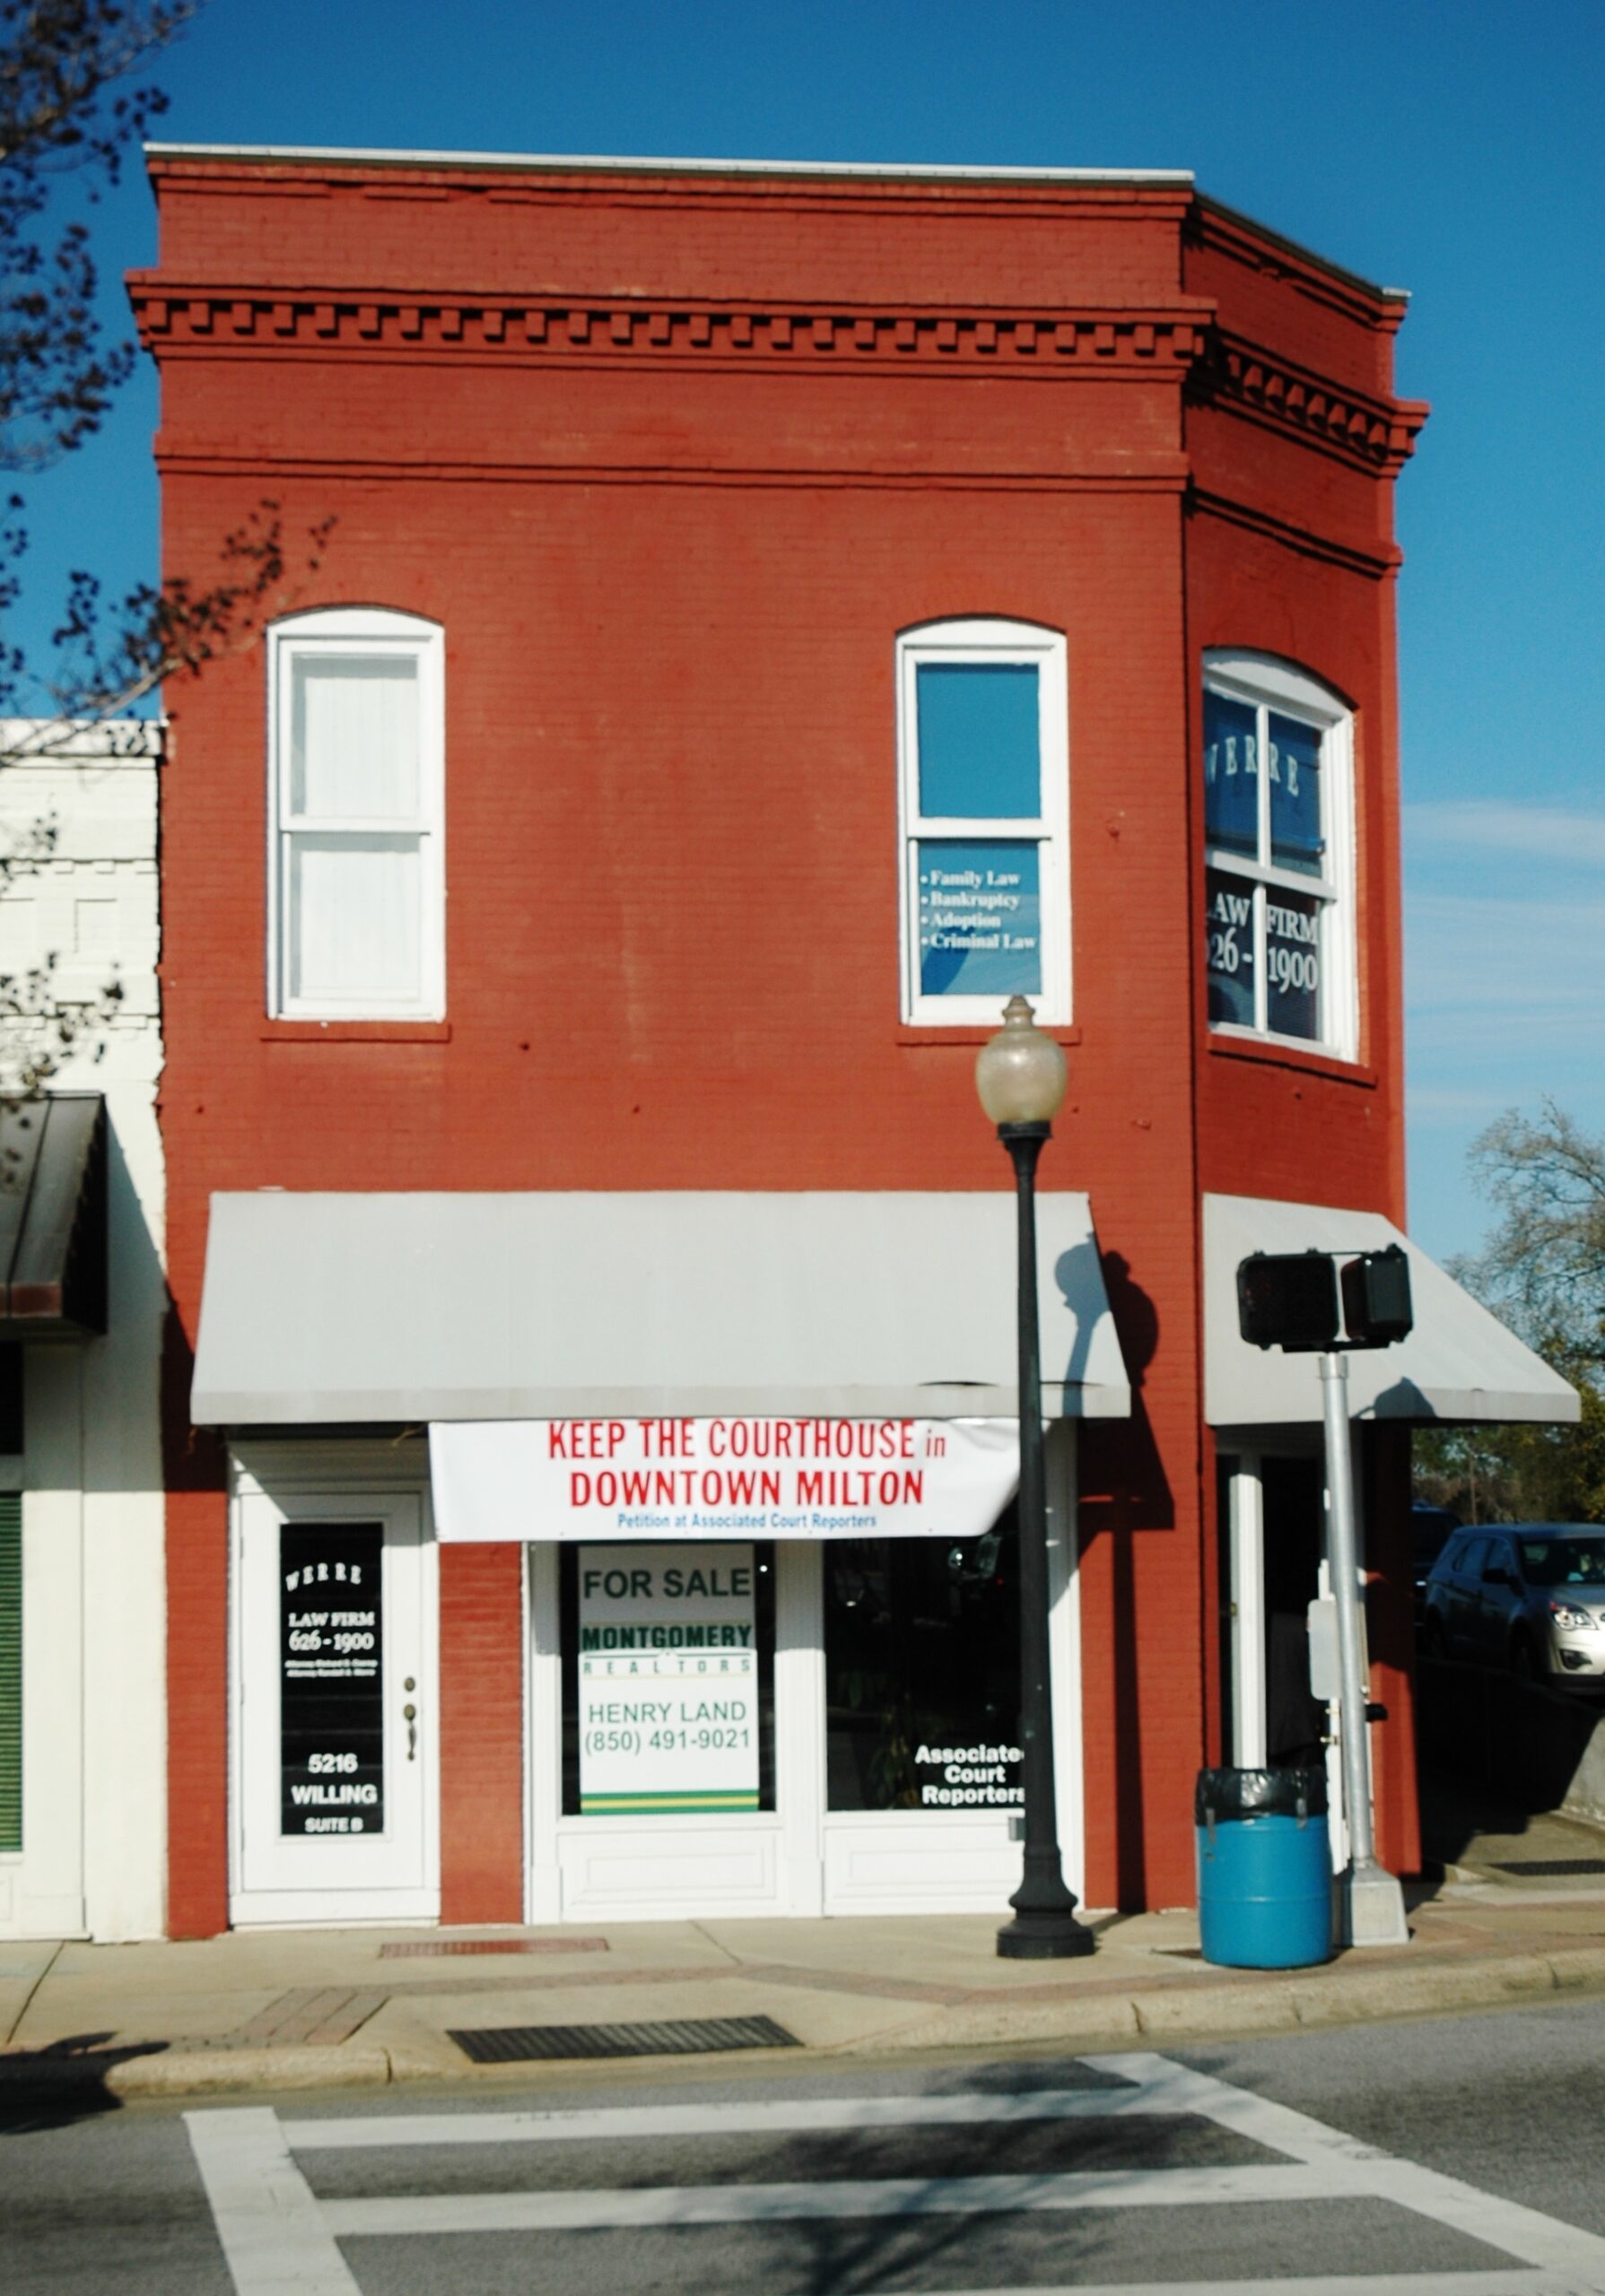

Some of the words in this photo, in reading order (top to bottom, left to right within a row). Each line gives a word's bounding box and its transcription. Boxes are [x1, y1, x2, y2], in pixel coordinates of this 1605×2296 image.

[930, 870, 982, 889] Family
[987, 871, 1021, 886] Law
[930, 891, 1021, 911] Bankruptcy
[931, 912, 1002, 931] Adoption
[1207, 891, 1252, 928] AW
[1266, 903, 1319, 946] FIRM
[930, 933, 999, 950] Criminal
[1003, 934, 1036, 950] Law
[549, 1420, 625, 1458] KEEP
[639, 1418, 695, 1457] THE
[709, 1418, 915, 1458] COURTHOUSE
[925, 1428, 946, 1457] in
[571, 1469, 781, 1508] DOWNTOWN
[797, 1469, 924, 1507] MILTON
[617, 1513, 671, 1528] Petition
[675, 1515, 687, 1527] at
[692, 1513, 765, 1528] Associated
[770, 1513, 807, 1528] Court
[811, 1513, 877, 1530] Reporters
[584, 1570, 653, 1600] FOR
[663, 1568, 752, 1598] SALE
[288, 1613, 329, 1628] LAW
[330, 1611, 376, 1627] FIRM
[582, 1624, 752, 1651] MONTGOMERY
[583, 1659, 751, 1674] REALTORS
[589, 1702, 672, 1724] HENRY
[681, 1700, 747, 1722] LAND
[585, 1729, 642, 1756] (850)
[649, 1727, 750, 1750] 491-9021
[308, 1752, 359, 1774] 5216
[914, 1744, 1025, 1764] Associate
[944, 1764, 1007, 1784] Court
[291, 1783, 379, 1805] WILLING
[304, 1817, 349, 1832] SUITE
